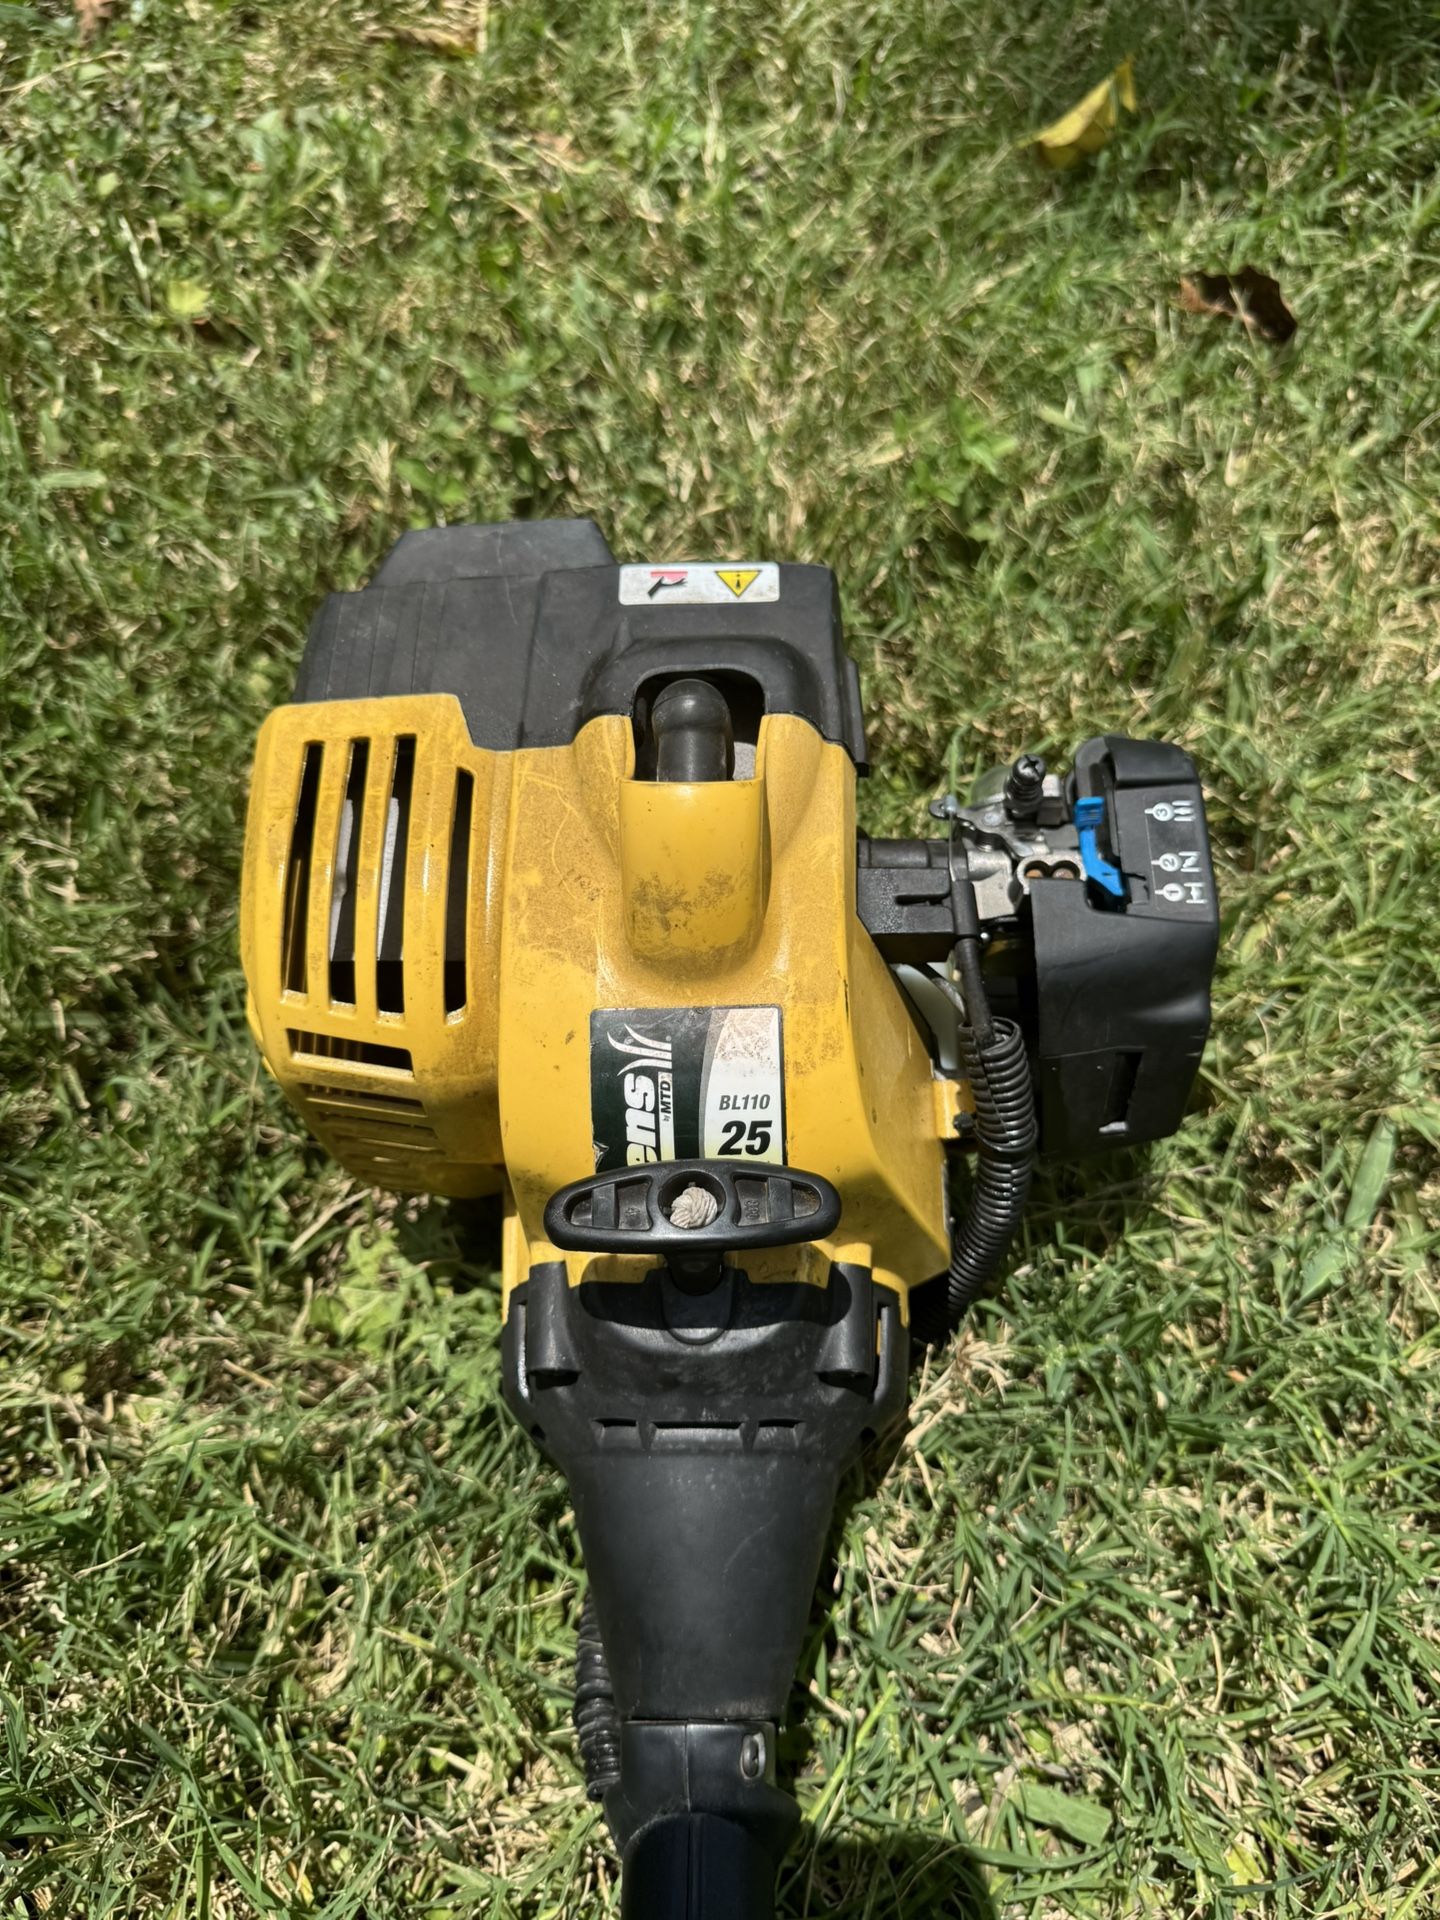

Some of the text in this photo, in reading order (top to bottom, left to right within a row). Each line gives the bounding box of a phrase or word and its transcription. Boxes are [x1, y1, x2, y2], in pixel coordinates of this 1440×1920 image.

[660, 1080, 671, 1114] MTD
[718, 1094, 771, 1111] BL110
[717, 1120, 773, 1156] 25
